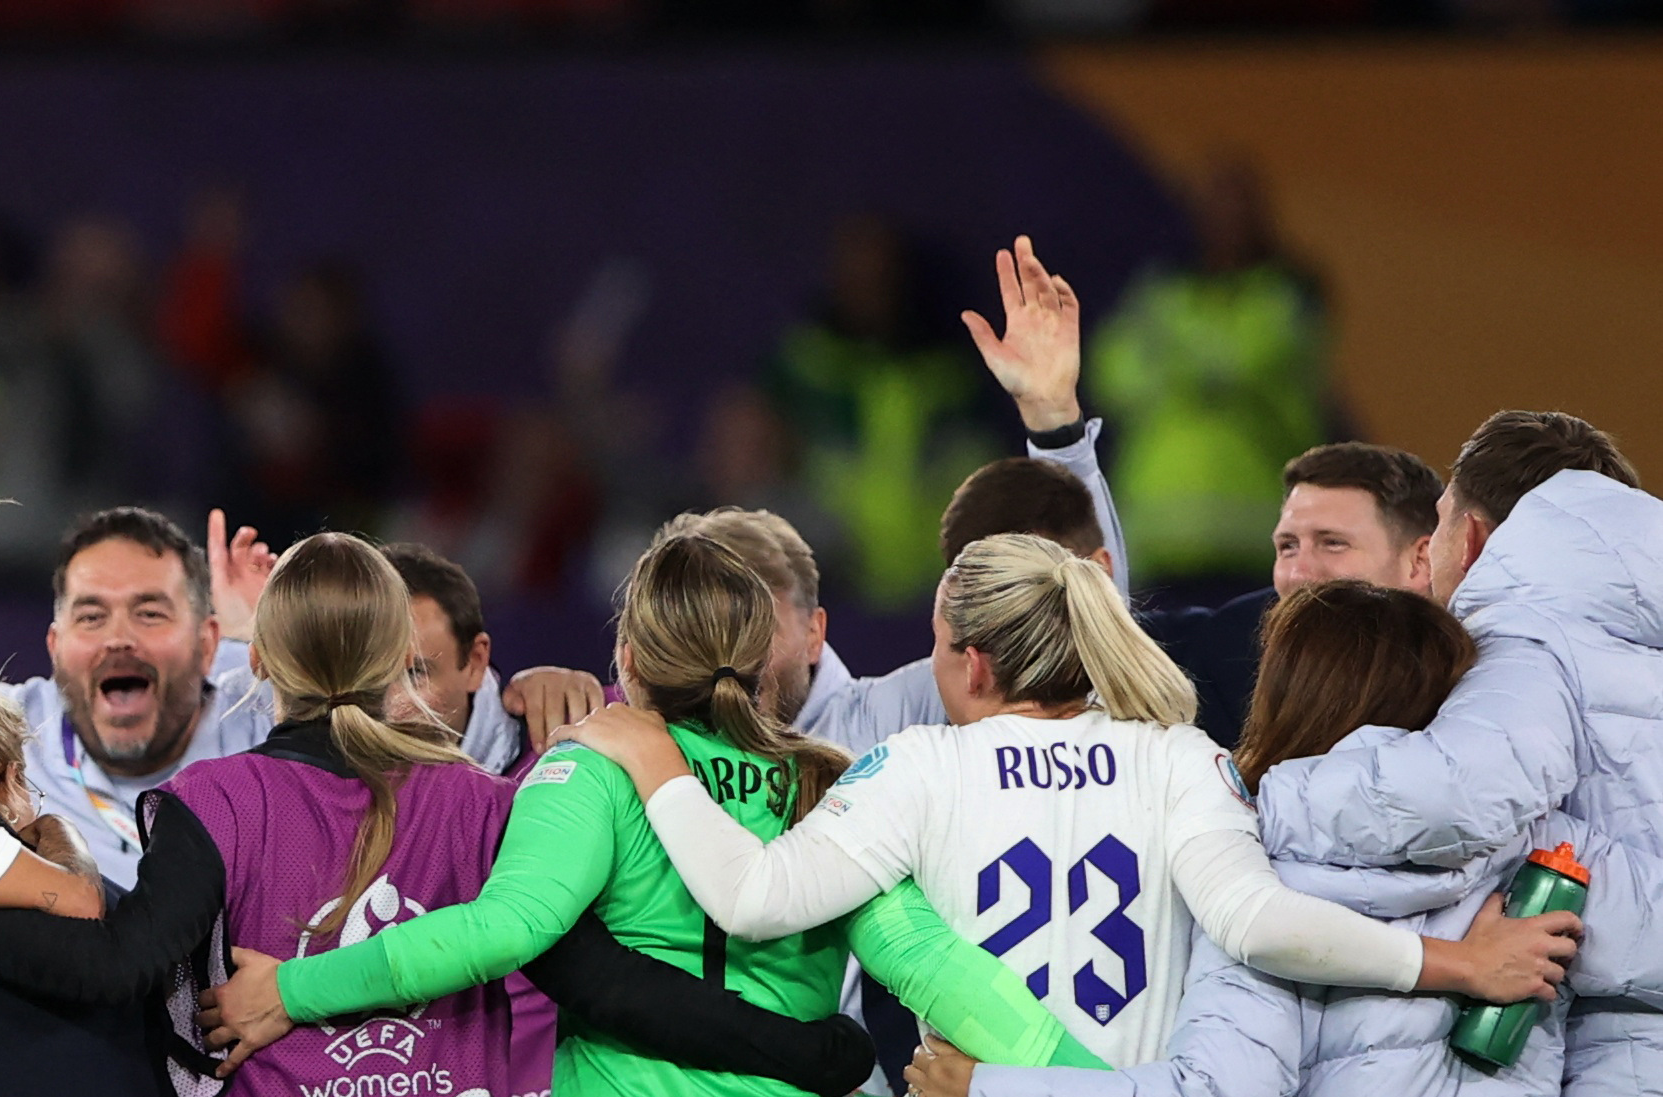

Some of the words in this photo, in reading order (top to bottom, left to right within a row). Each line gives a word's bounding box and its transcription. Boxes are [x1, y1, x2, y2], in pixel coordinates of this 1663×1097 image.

[691, 756, 790, 818] ARPS
[995, 741, 1117, 791] RUSSO
[977, 833, 1148, 1027] 23
[330, 1024, 416, 1065] UEFA
